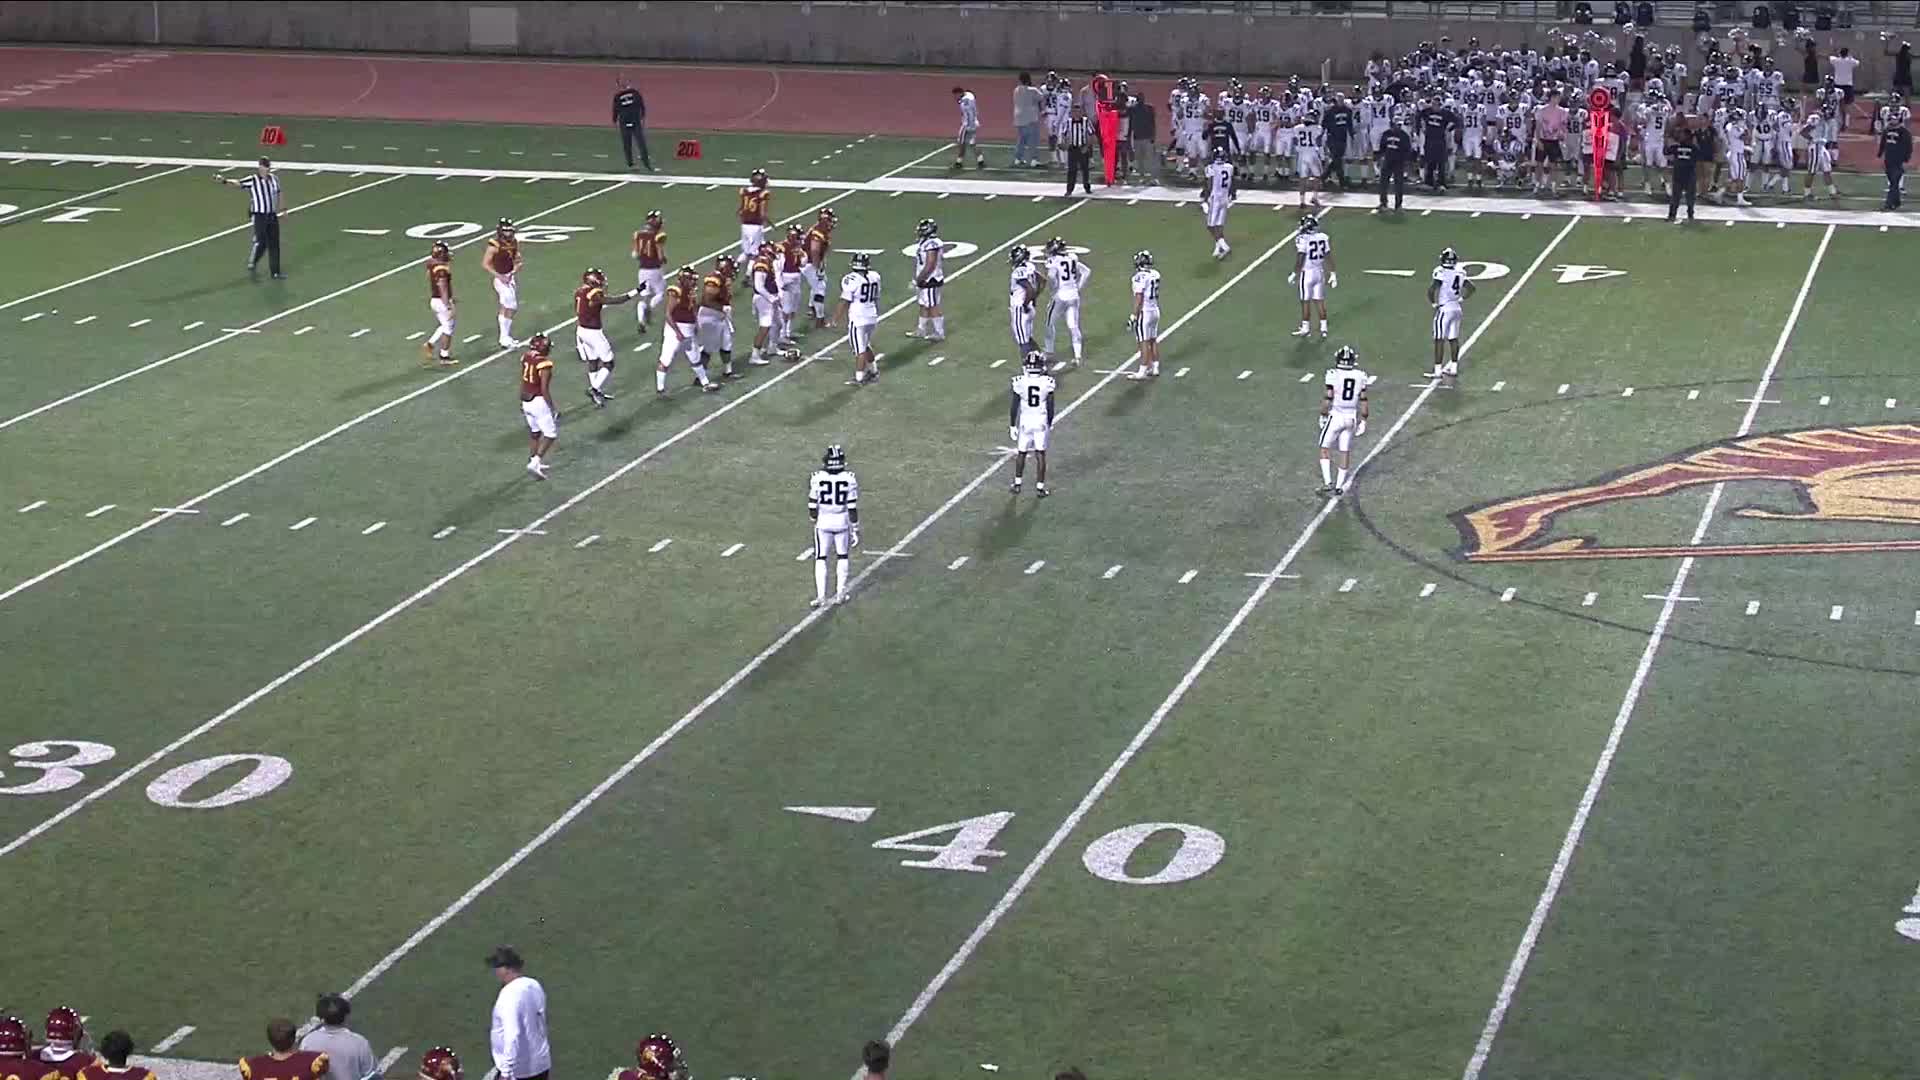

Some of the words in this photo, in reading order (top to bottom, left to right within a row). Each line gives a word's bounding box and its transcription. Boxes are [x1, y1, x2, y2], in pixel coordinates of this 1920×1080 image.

[1229, 109, 1243, 123] 99
[1257, 110, 1269, 122] 19
[1466, 116, 1477, 128] 31
[1656, 116, 1663, 129] 5
[262, 127, 277, 144] 10
[1299, 131, 1313, 147] 21
[677, 141, 695, 157] 20
[1221, 170, 1228, 188] 2
[744, 196, 757, 212] 16
[1309, 240, 1326, 260] 23
[1060, 260, 1077, 281] 34
[860, 282, 878, 304] 90
[1450, 273, 1460, 295] 4
[523, 362, 534, 384] 21
[1028, 386, 1040, 407] 6
[1342, 378, 1355, 401] 8
[819, 481, 848, 505] 26
